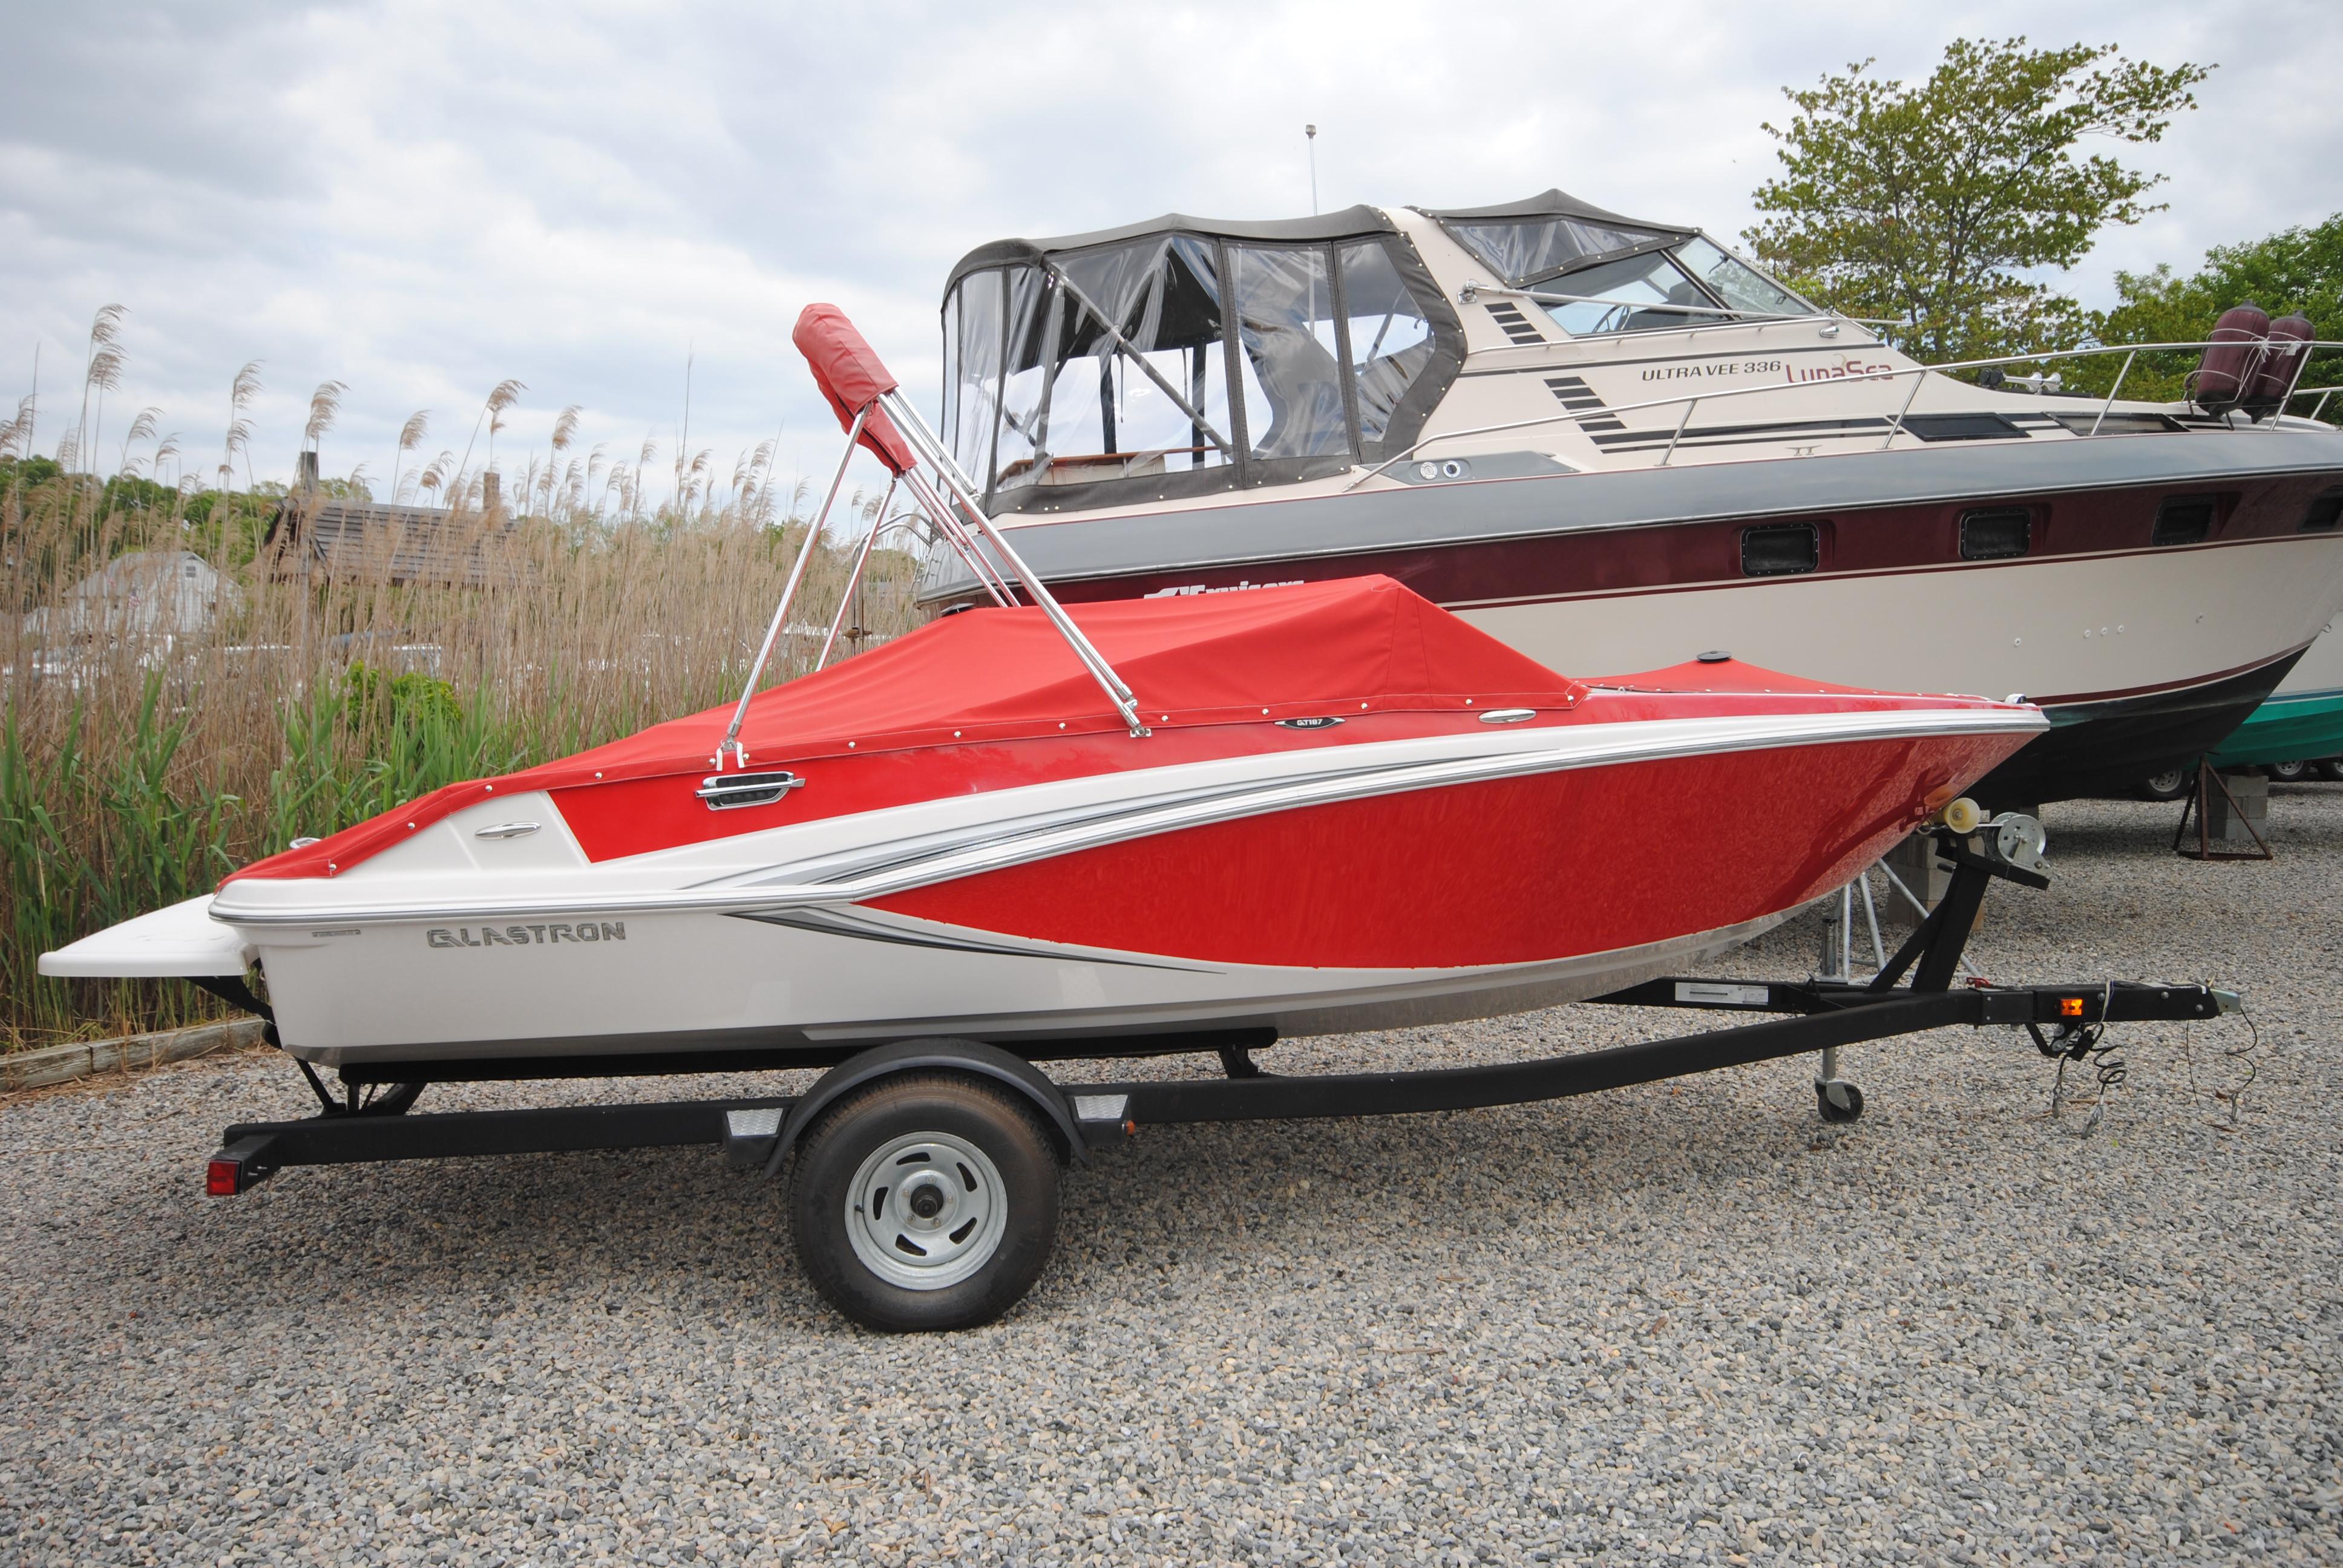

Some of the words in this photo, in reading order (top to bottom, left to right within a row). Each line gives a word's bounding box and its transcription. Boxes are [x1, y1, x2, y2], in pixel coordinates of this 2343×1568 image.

[1642, 367, 1702, 381] ULTRA
[1706, 363, 1739, 376] VEE
[1743, 361, 1781, 373] 336
[1297, 718, 1323, 727] GT187
[427, 921, 626, 948] GLASTRON
